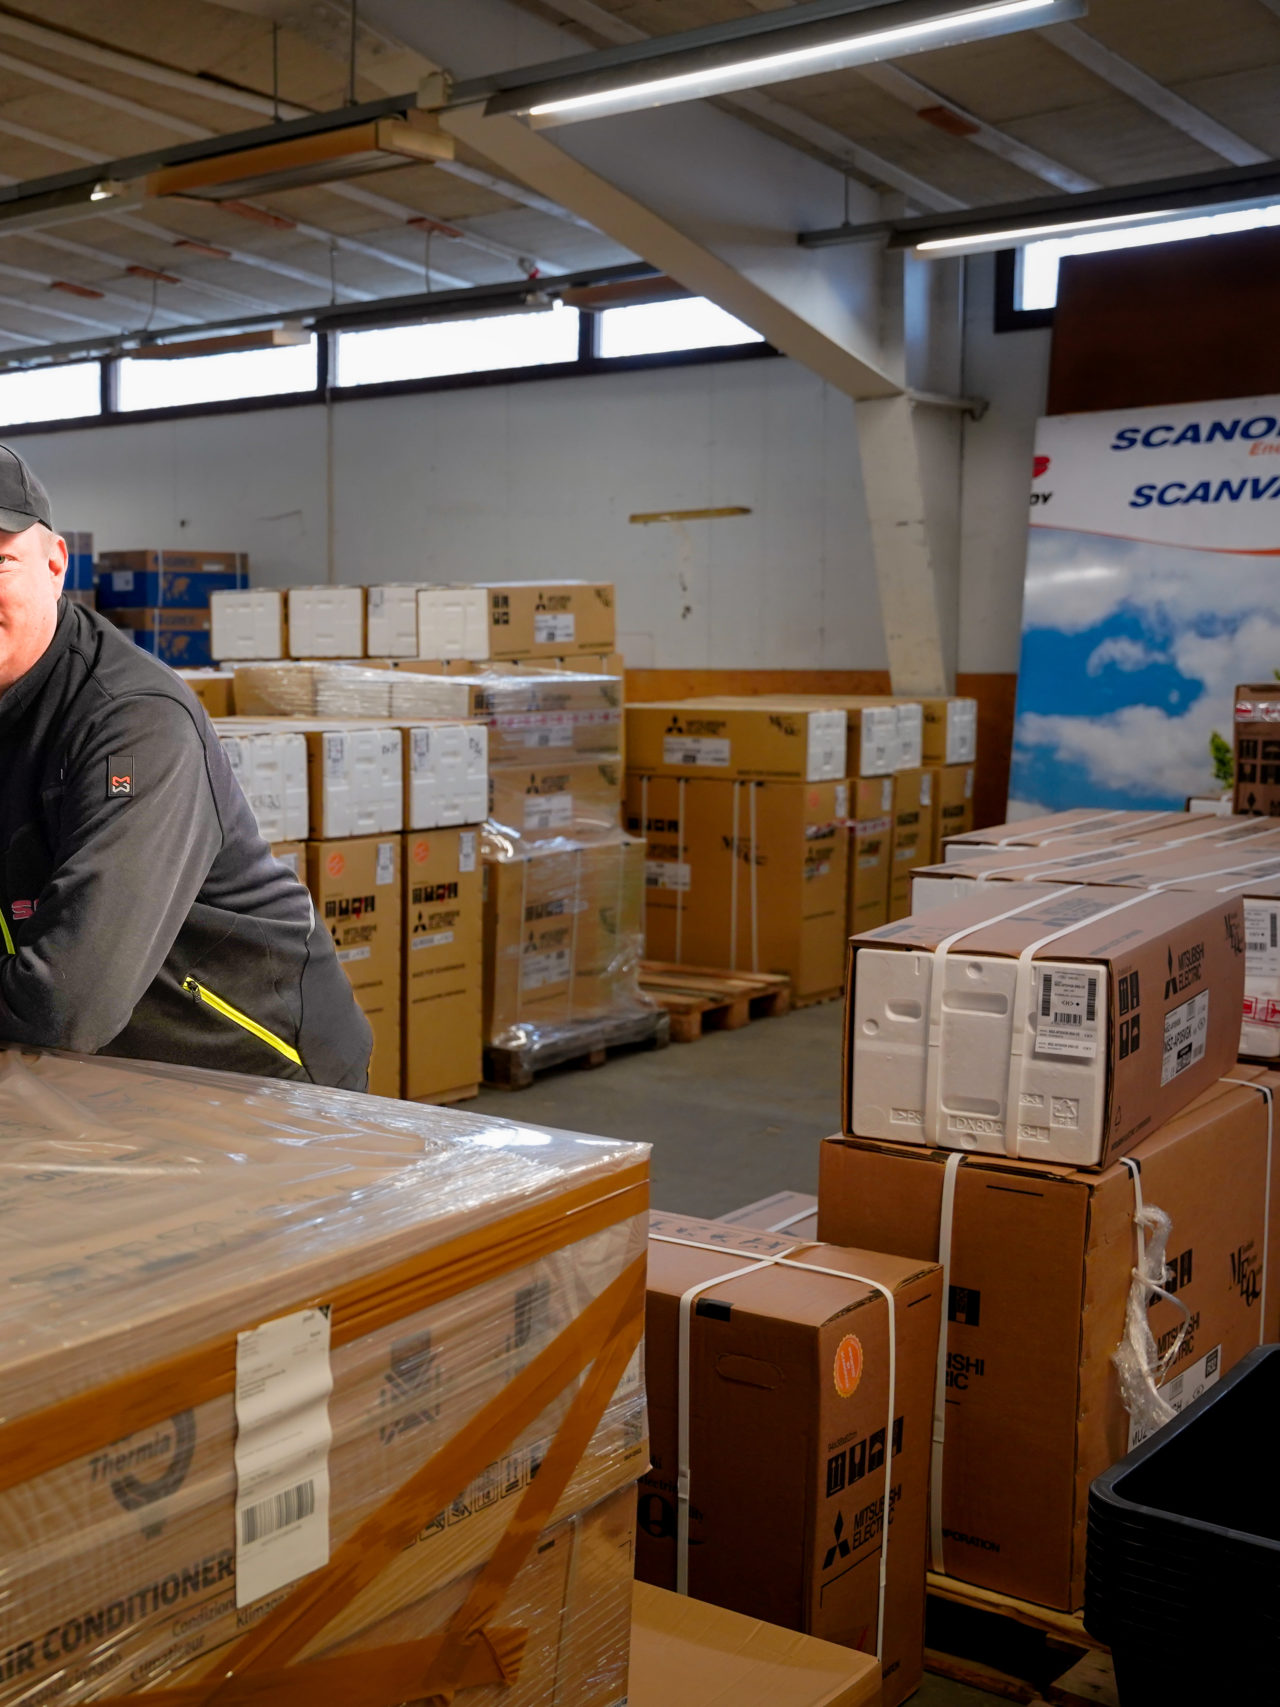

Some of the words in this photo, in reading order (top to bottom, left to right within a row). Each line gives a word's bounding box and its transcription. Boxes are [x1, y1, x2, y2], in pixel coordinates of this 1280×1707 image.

[1111, 417, 1280, 450] SCANO
[1177, 942, 1205, 971] MITSUBISHI
[1177, 963, 1203, 992] ELECTRIC
[90, 1431, 173, 1483] Thermia
[854, 1483, 902, 1529] MITSUBSHI
[41, 1550, 236, 1662] CONDITIONER
